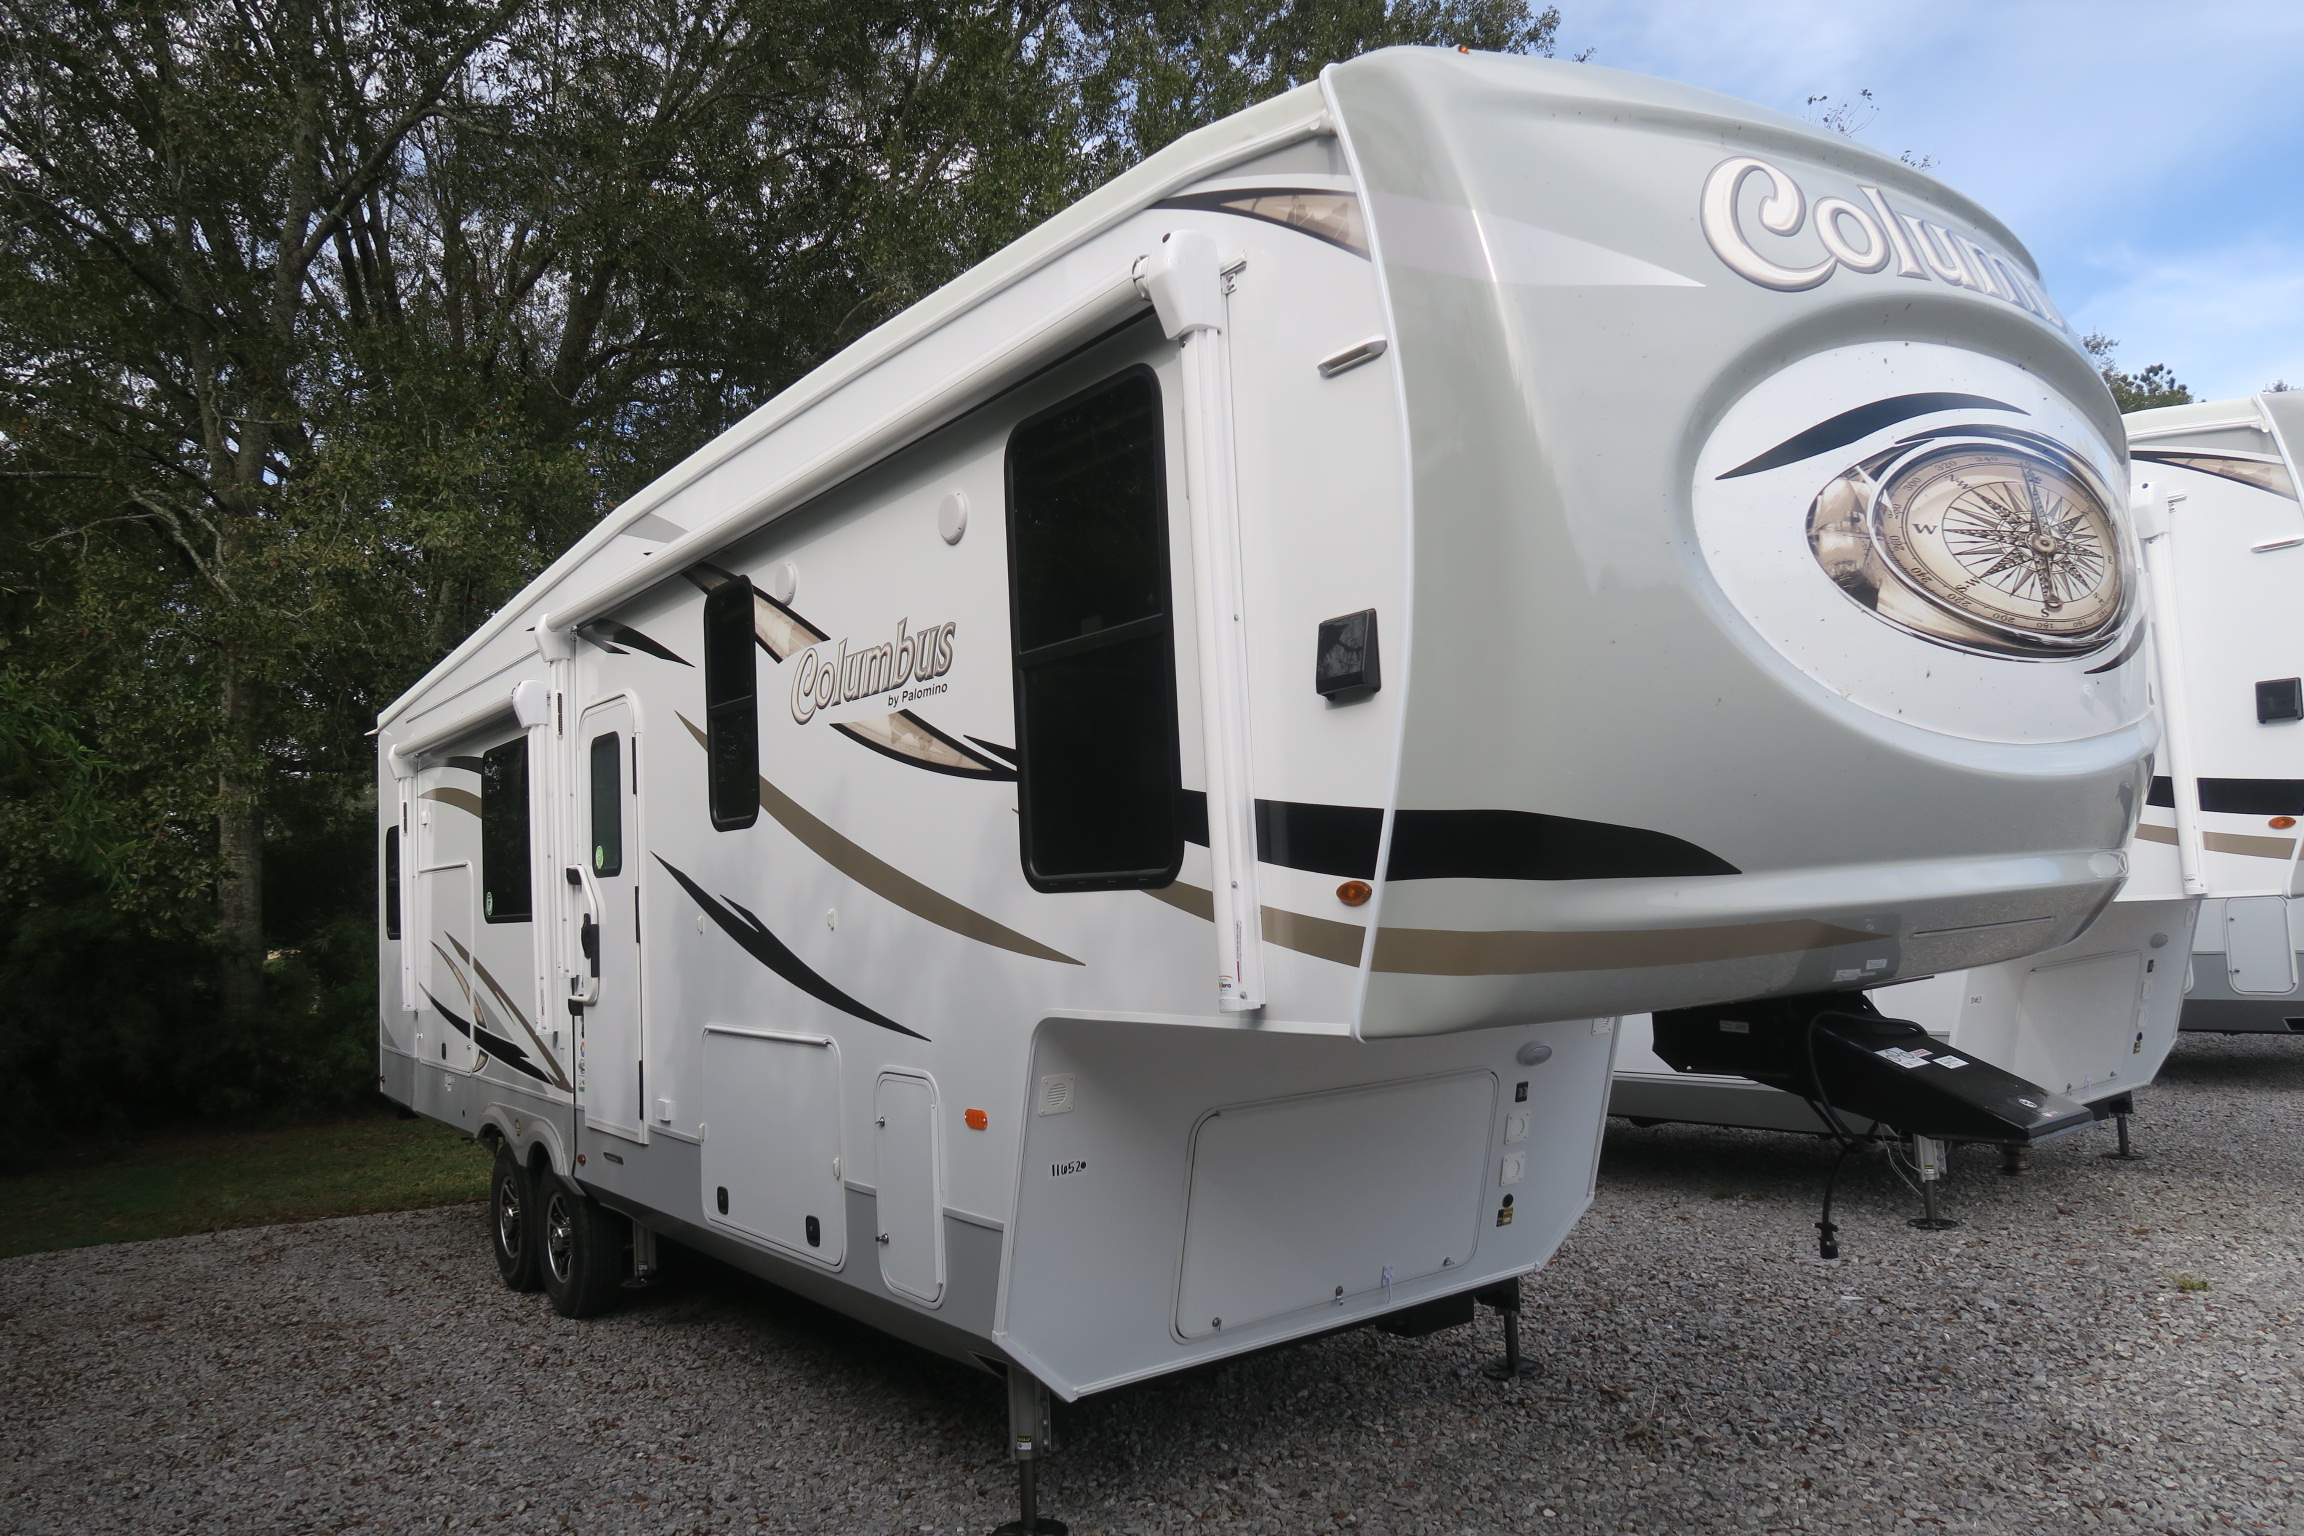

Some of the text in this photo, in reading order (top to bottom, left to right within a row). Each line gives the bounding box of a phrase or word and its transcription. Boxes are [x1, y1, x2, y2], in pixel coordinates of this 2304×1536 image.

[1934, 461, 1957, 471] 320
[1903, 477, 1921, 492] 300
[1912, 523, 1938, 535] W
[1911, 567, 1933, 583] 240
[1947, 593, 1972, 607] 220
[1992, 612, 2016, 624] 200
[2041, 608, 2050, 618] S
[2073, 620, 2087, 628] 160
[790, 616, 957, 725] Columbus
[888, 683, 948, 708] by Palomino
